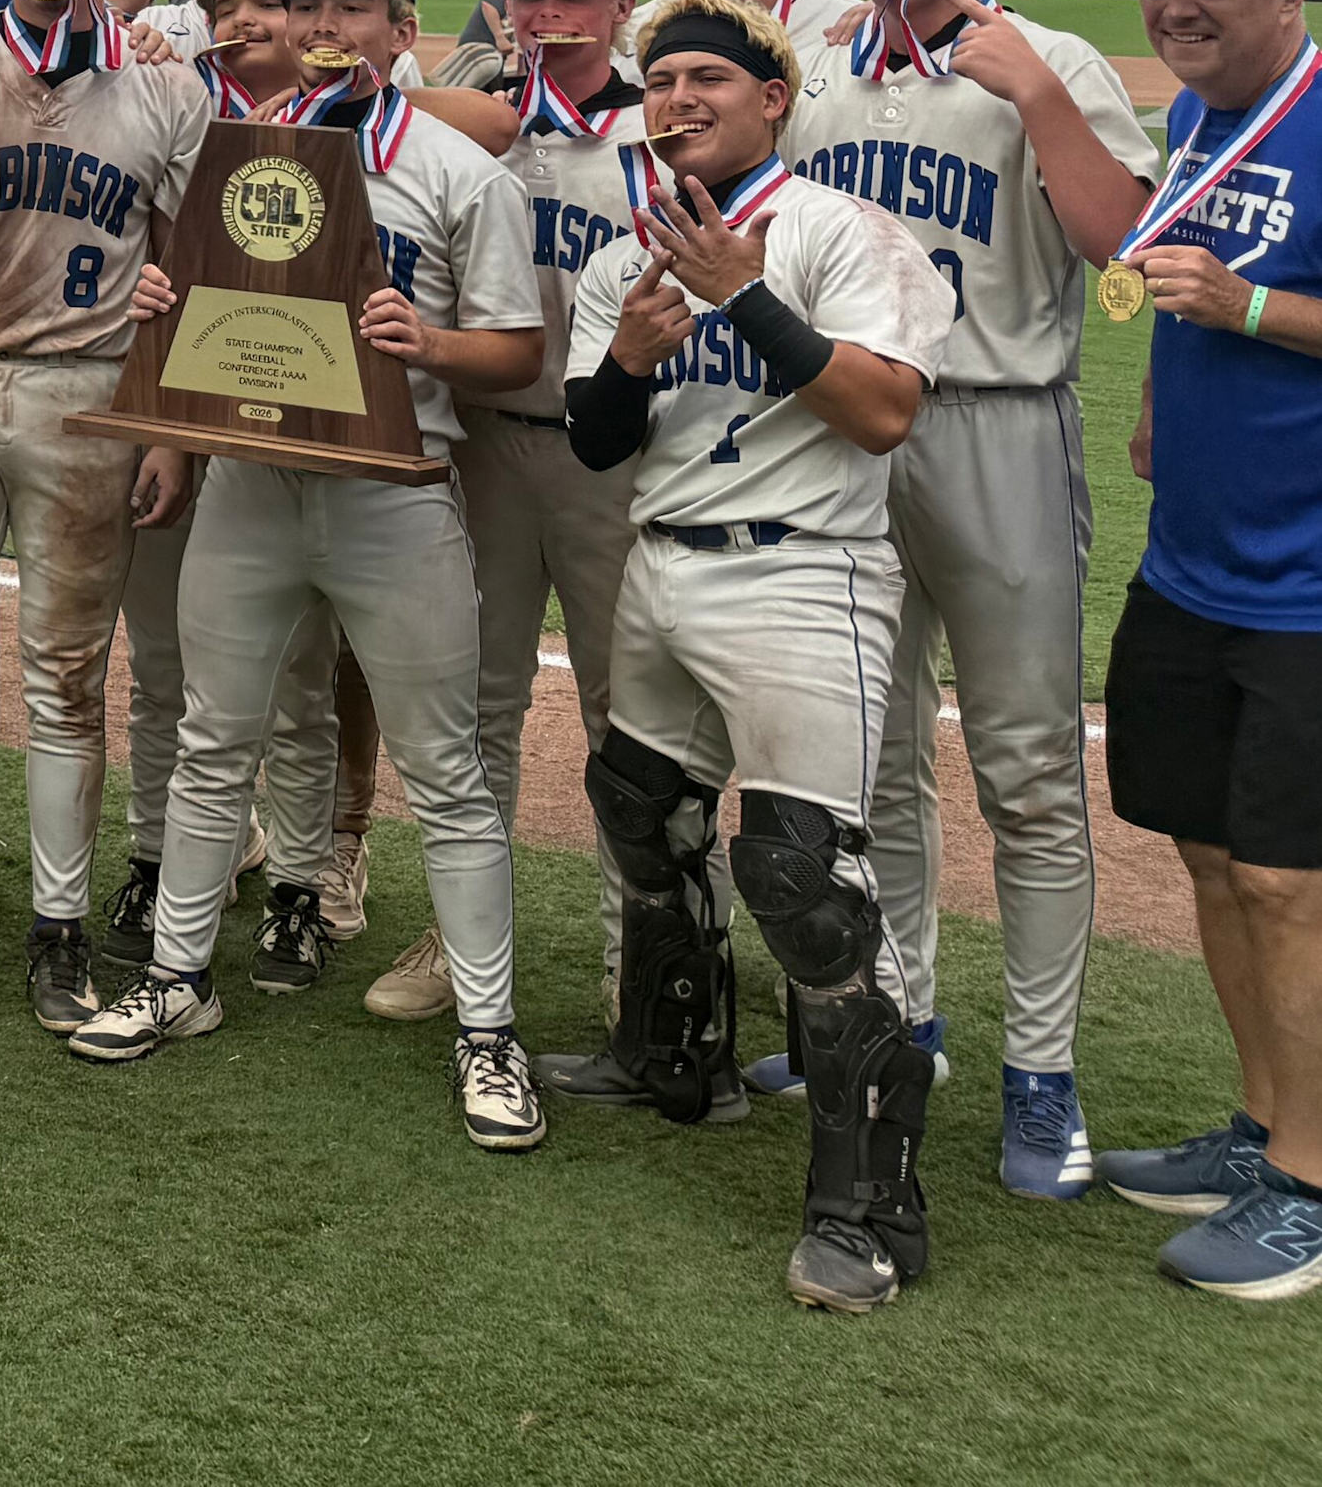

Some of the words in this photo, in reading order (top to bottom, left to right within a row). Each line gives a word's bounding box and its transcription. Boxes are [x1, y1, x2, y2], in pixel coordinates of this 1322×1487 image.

[240, 177, 304, 228] UIL
[250, 224, 291, 239] STATE
[63, 244, 104, 308] 8
[191, 312, 233, 351] UNIVERSITY
[234, 305, 314, 336] INTERSCHOLASTIC
[310, 331, 337, 366] LEAGUE
[225, 338, 252, 350] STATE
[254, 341, 304, 356] CHAMPION
[240, 352, 286, 366] BASEBALL
[218, 362, 279, 377] CONFERENCE
[280, 370, 307, 382] AAAA
[238, 377, 277, 389] DIVISION
[249, 407, 272, 419] 2026
